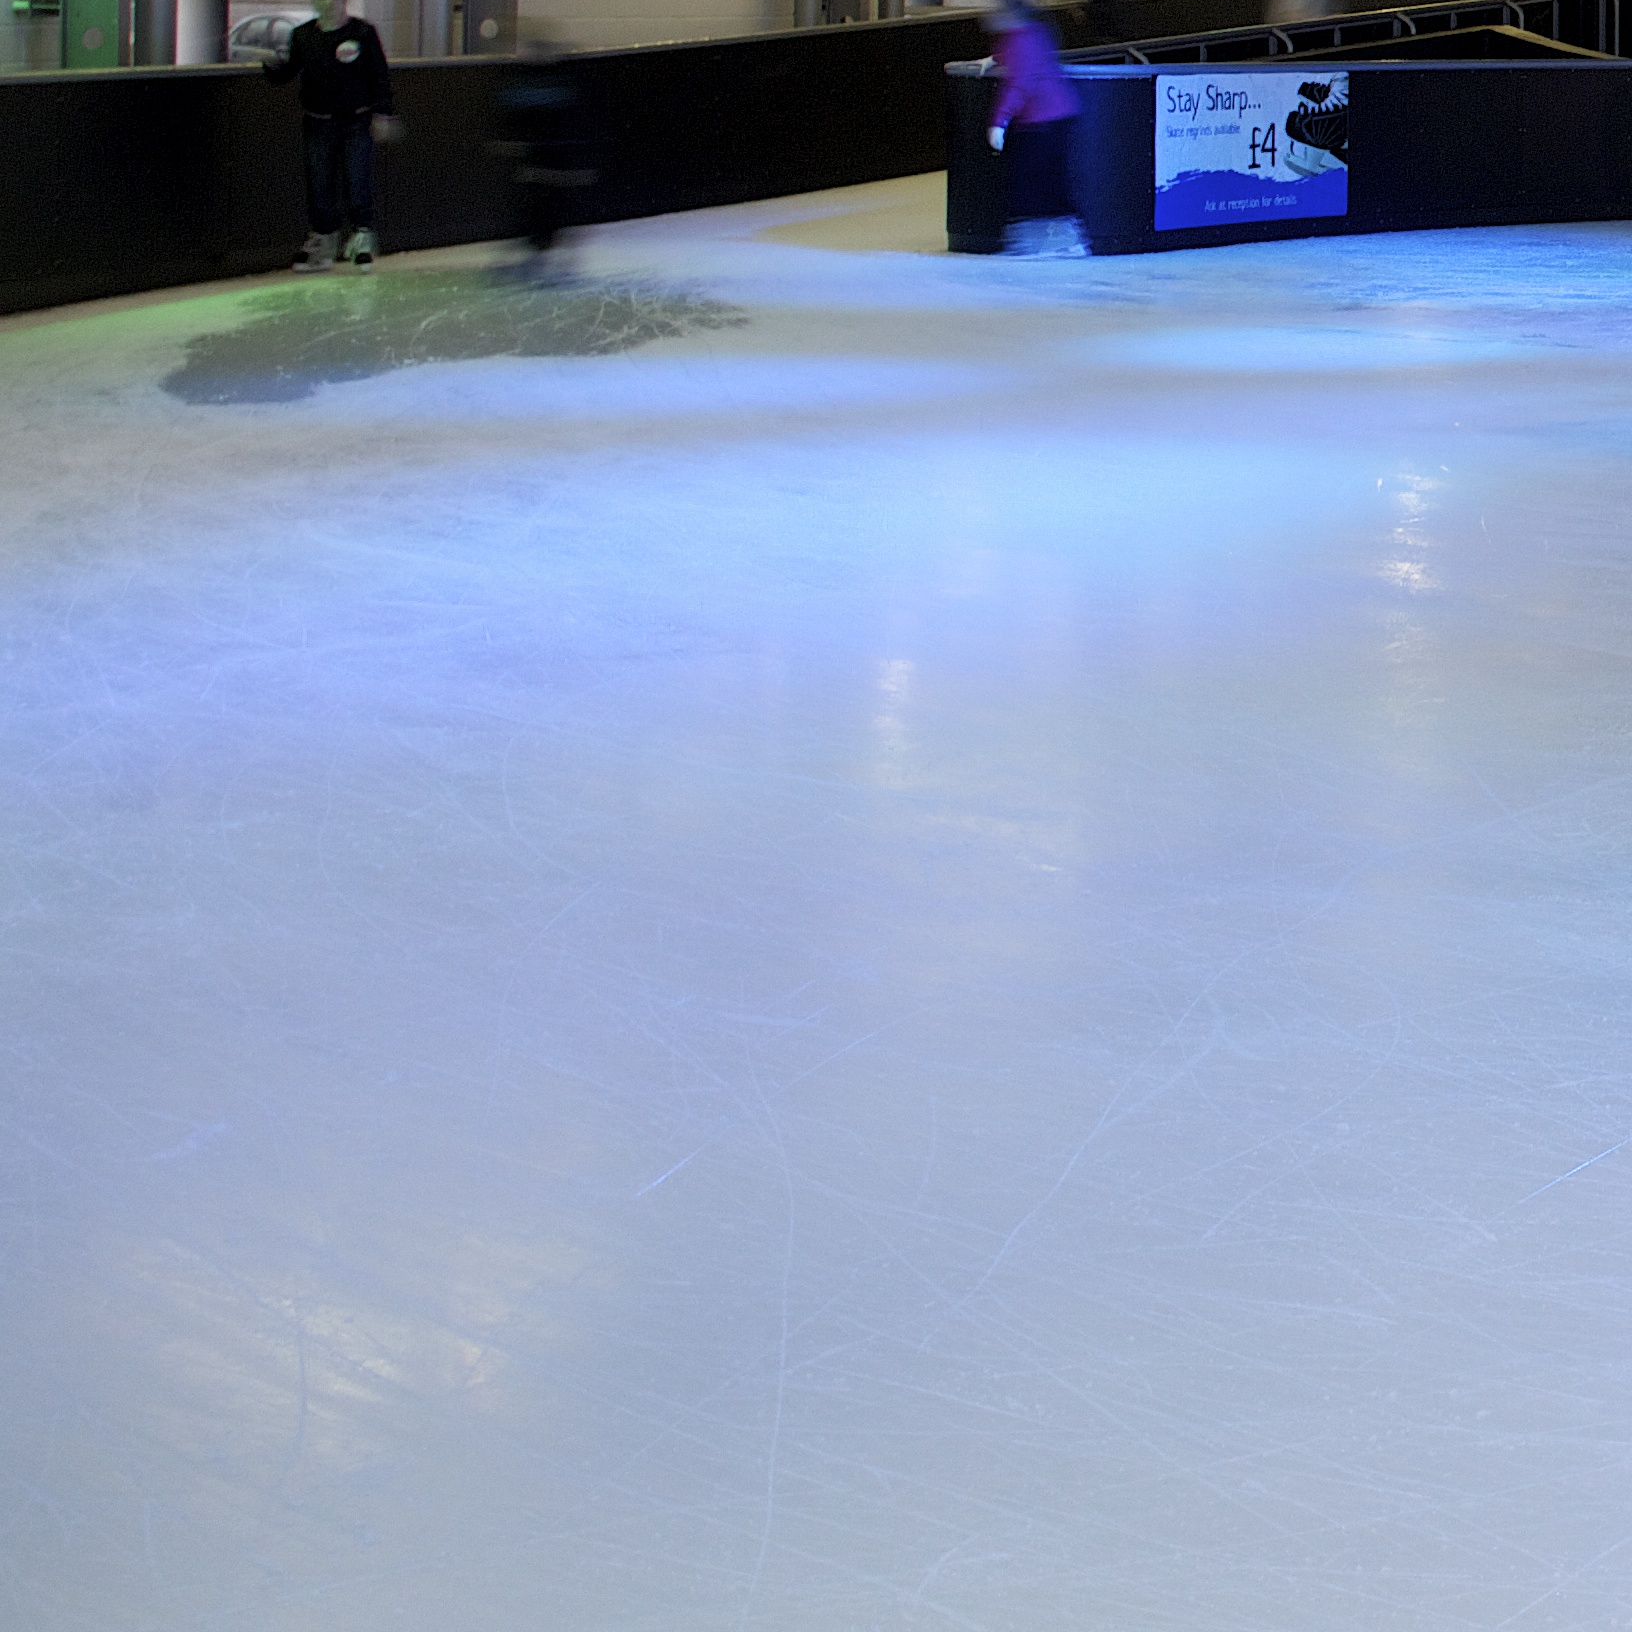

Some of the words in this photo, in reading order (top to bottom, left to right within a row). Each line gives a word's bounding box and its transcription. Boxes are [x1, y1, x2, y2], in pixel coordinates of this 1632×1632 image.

[1167, 85, 1200, 121] Stay
[1206, 84, 1261, 118] Sharp...
[1248, 122, 1277, 169] £4
